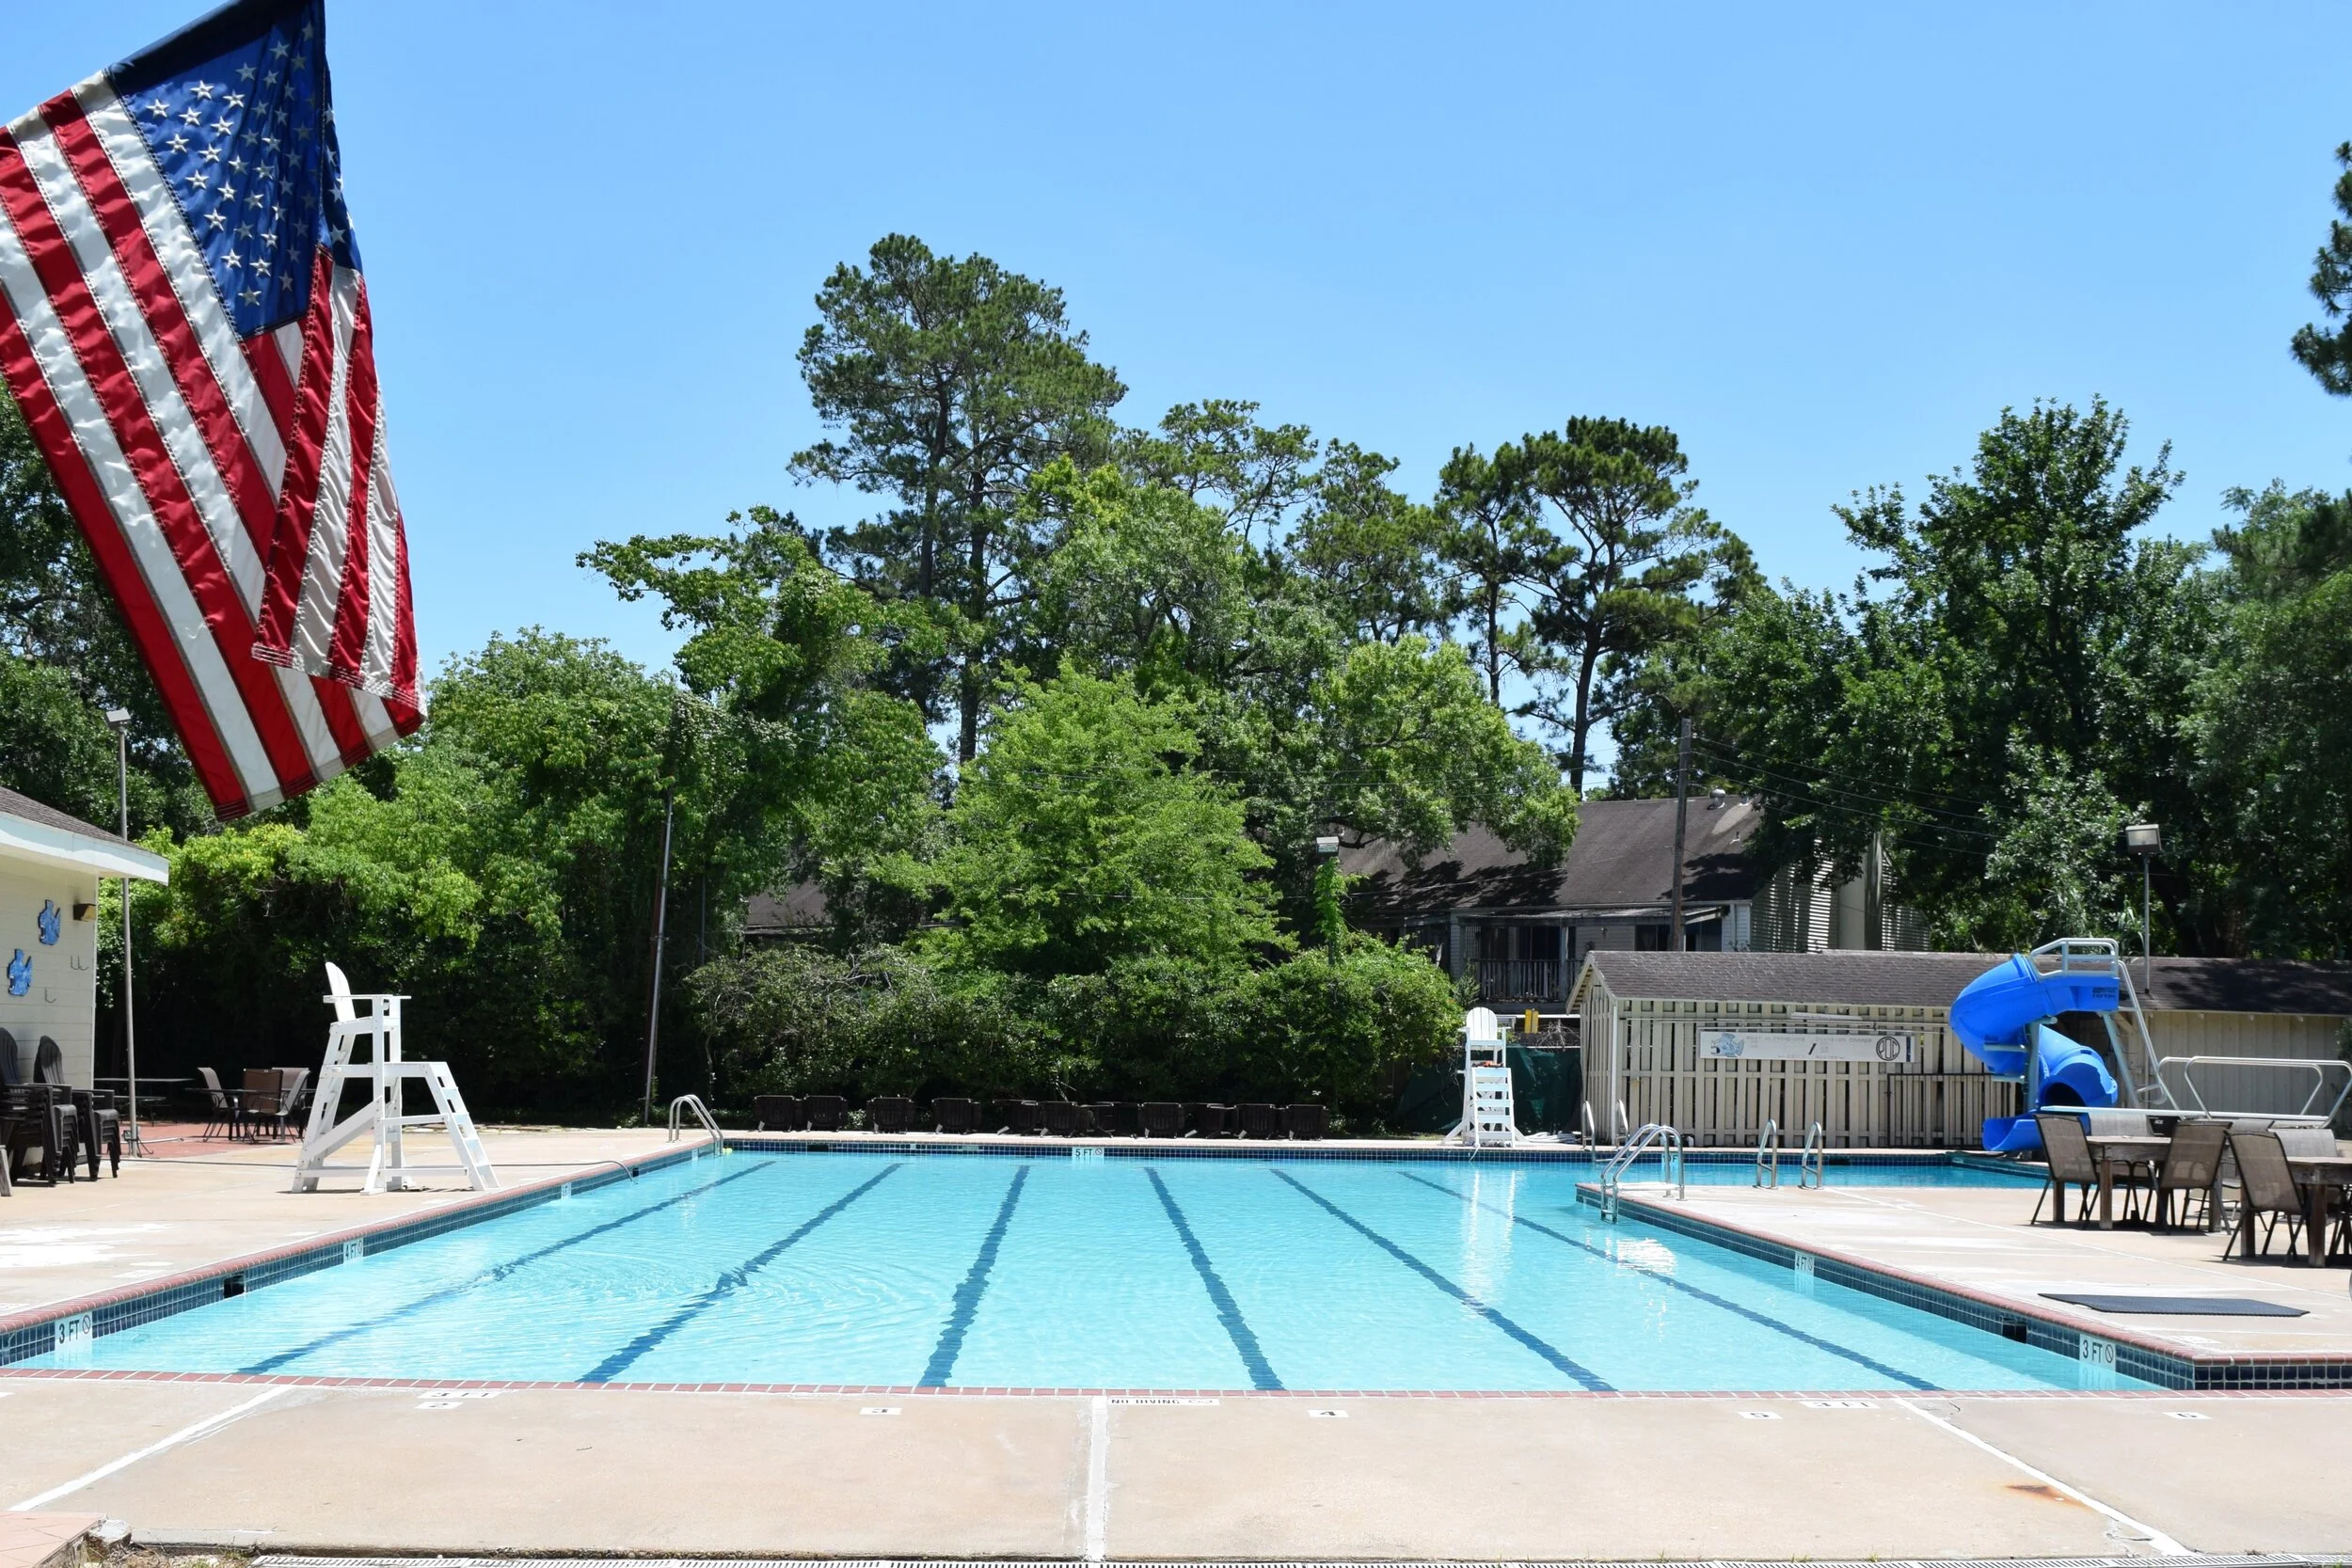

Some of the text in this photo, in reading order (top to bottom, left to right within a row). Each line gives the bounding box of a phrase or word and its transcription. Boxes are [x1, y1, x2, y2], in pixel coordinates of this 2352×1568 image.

[1075, 1148, 1081, 1157] 5
[350, 1243, 358, 1259] FT
[1800, 1256, 1807, 1271] FT
[58, 1319, 80, 1345] 3 FT
[2082, 1338, 2103, 1364] 3 FT
